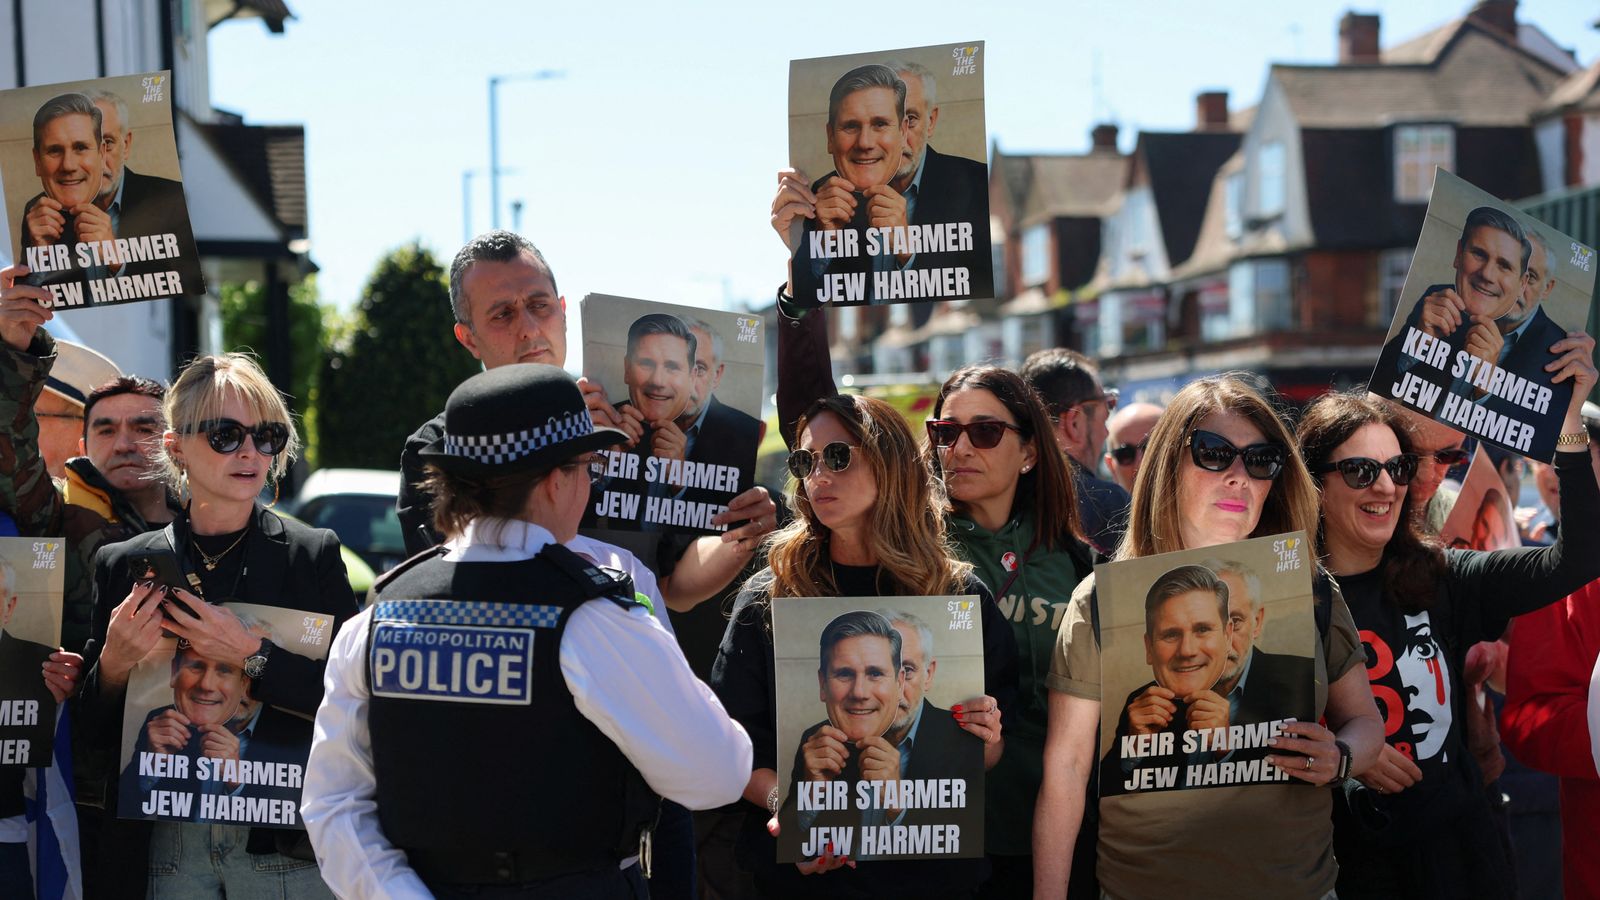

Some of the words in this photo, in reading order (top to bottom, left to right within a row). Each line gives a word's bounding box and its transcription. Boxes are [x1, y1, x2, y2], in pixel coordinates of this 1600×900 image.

[955, 56, 975, 66] THE
[952, 65, 977, 76] HATE
[142, 94, 163, 103] HATE
[145, 86, 162, 96] THE
[809, 228, 859, 259] KEIR
[866, 222, 974, 257] STARMER
[26, 244, 72, 273] KEIR
[75, 233, 181, 268] STARMER
[1573, 250, 1589, 265] THE
[1570, 256, 1590, 271] HATE
[88, 270, 184, 303] HARMER
[816, 272, 866, 303] JEW
[873, 266, 970, 300] HARMER
[737, 333, 758, 344] HATE
[740, 326, 757, 336] THE
[1401, 326, 1451, 371] KEIR
[1451, 350, 1553, 415] STARMER
[1391, 372, 1442, 413] JEW
[1440, 392, 1536, 452] HARMER
[644, 456, 740, 493] STARMER
[595, 490, 640, 520] JEW
[36, 551, 55, 561] THE
[1278, 549, 1298, 561] THE
[32, 560, 56, 569] HATE
[1276, 559, 1300, 572] HATE
[951, 610, 971, 620] THE
[305, 626, 323, 636] THE
[949, 620, 973, 630] HATE
[300, 634, 323, 645] HATE
[377, 629, 524, 650] METROPOLITAN
[374, 647, 523, 696] POLICE
[1120, 732, 1175, 759] KEIR
[139, 752, 190, 780] KEIR
[196, 757, 302, 788] STARMER
[1124, 765, 1179, 791] JEW
[797, 780, 849, 811] KEIR
[856, 778, 967, 810] STARMER
[142, 790, 193, 818] JEW
[200, 794, 296, 825] HARMER
[861, 824, 961, 856] HARMER
